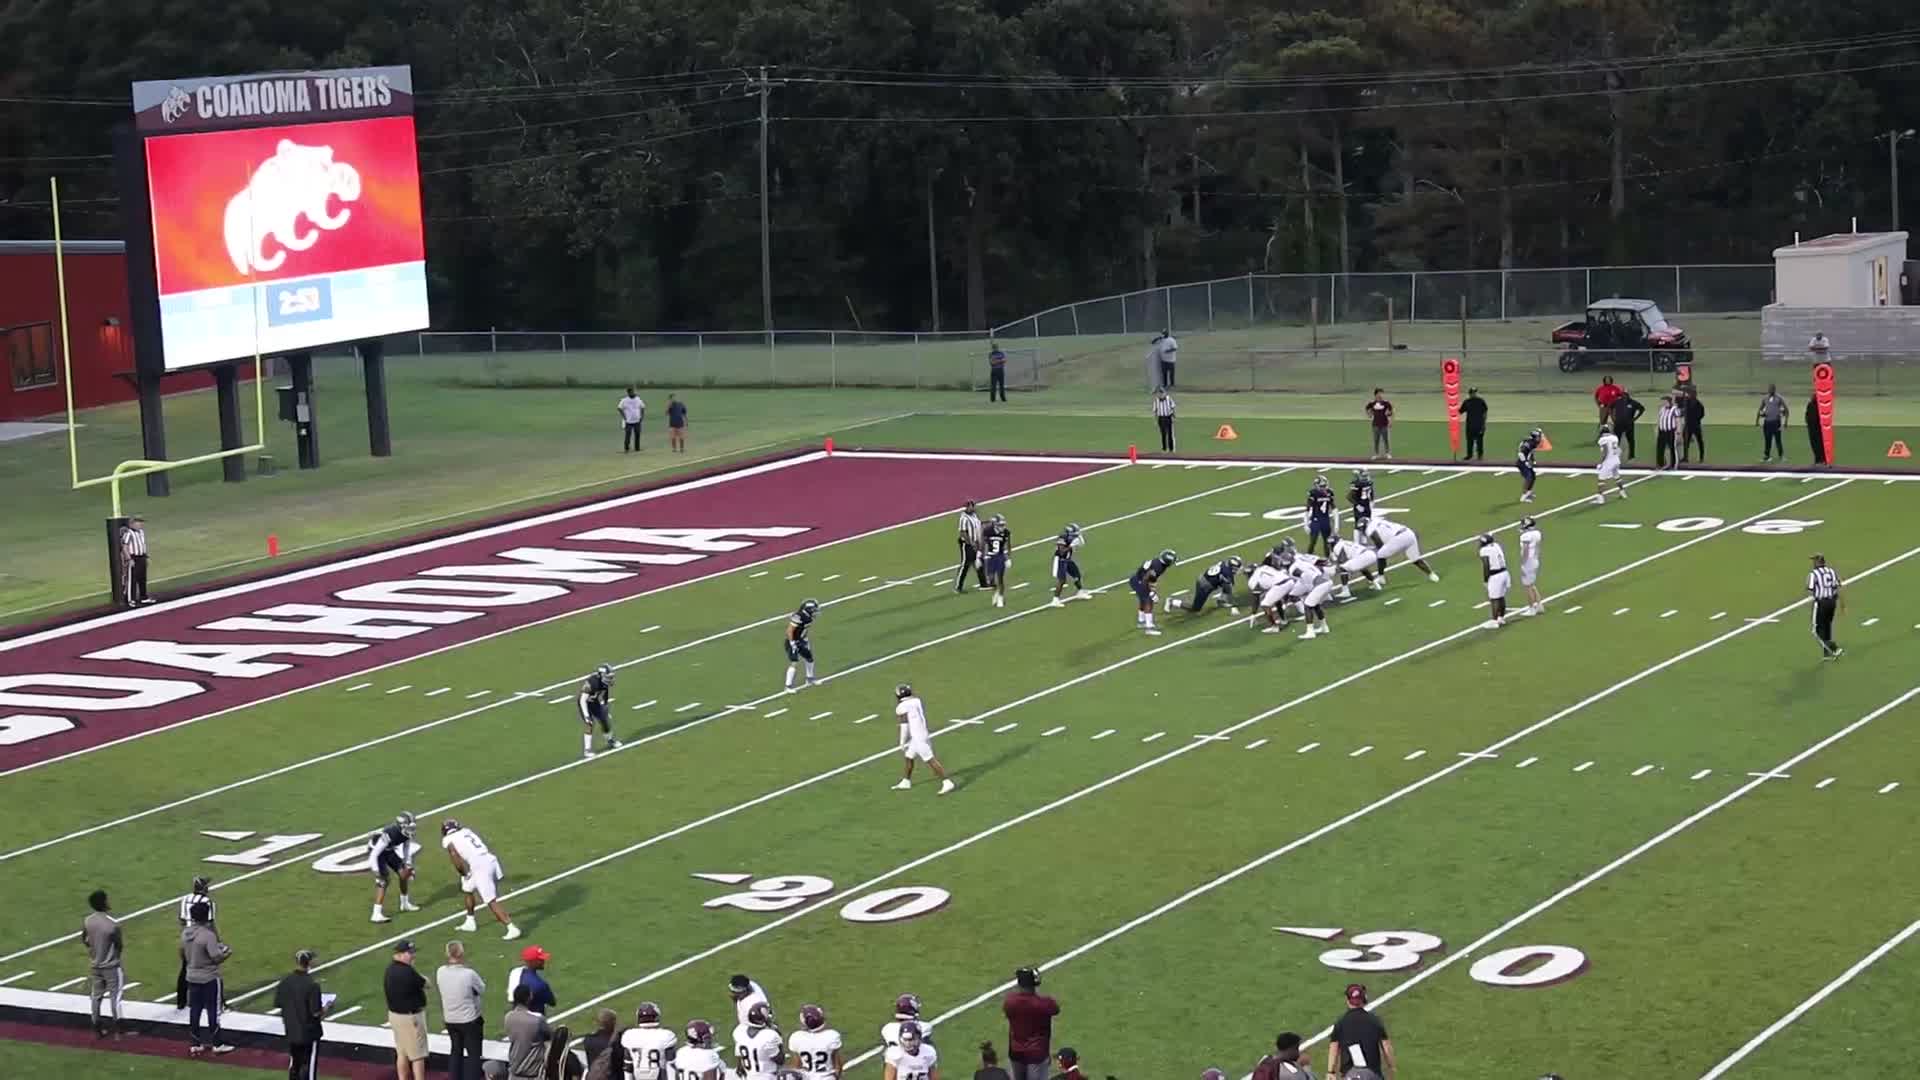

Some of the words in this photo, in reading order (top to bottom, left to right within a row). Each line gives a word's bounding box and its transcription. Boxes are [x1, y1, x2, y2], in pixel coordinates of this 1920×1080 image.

[196, 79, 311, 119] COAHOMA
[314, 75, 392, 111] TIGERS
[1320, 501, 1327, 514] 4
[700, 875, 951, 922] 20
[1318, 930, 1585, 986] 30
[739, 1045, 760, 1073] 81
[800, 1051, 828, 1073] 32
